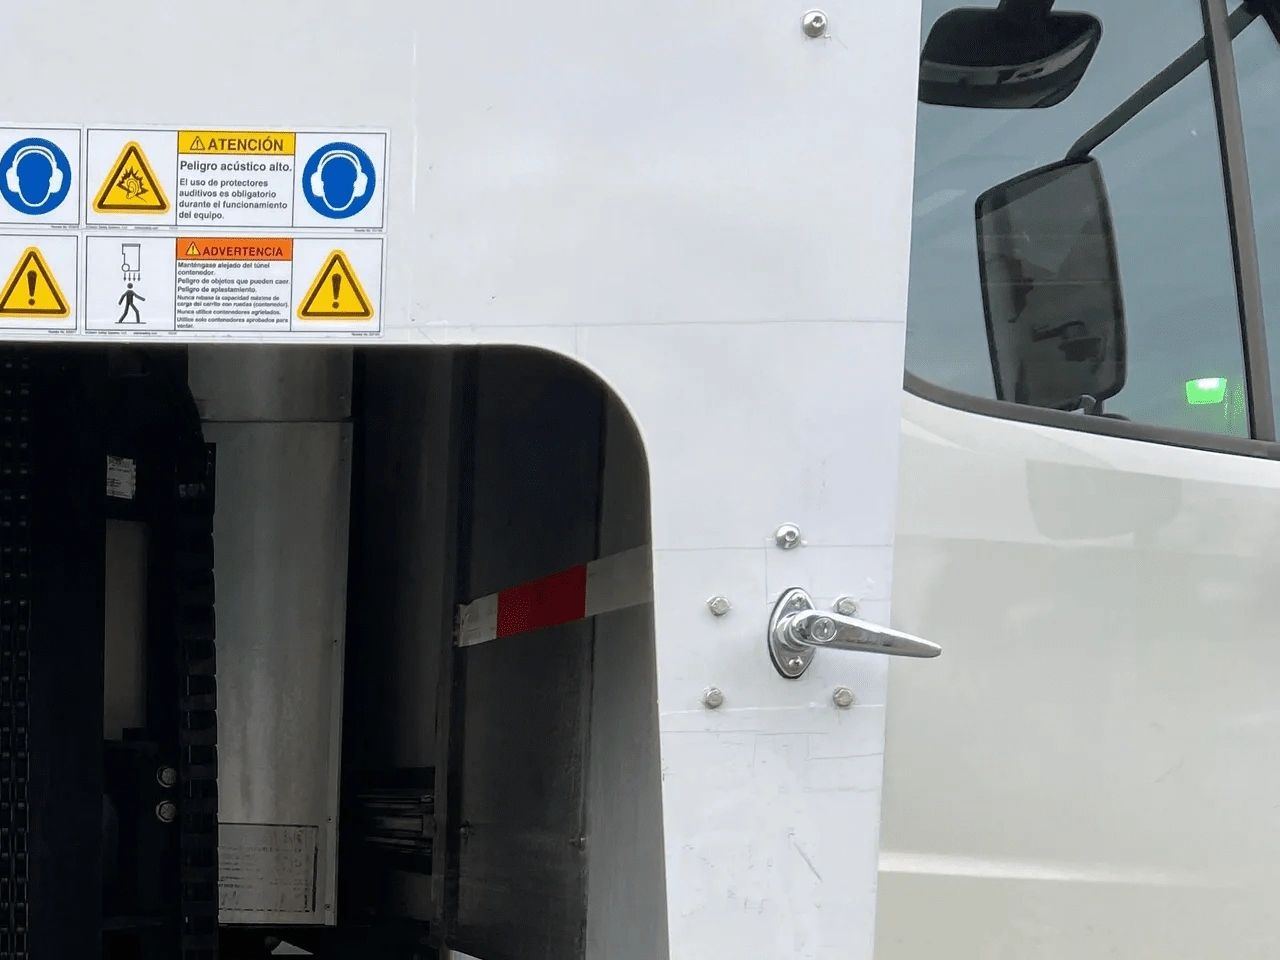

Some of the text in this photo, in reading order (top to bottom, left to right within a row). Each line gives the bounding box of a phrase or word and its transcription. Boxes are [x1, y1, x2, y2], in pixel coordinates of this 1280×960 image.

[208, 136, 283, 151] ATENCIÓN
[180, 160, 292, 173] Peligro acústico alto.
[179, 178, 187, 186] El
[208, 178, 218, 186] de
[220, 179, 268, 188] protectores
[179, 189, 217, 197] auditivos
[232, 190, 277, 199] obligatorio
[179, 200, 211, 208] durante
[222, 201, 288, 209] funcionamiento
[178, 211, 224, 220] del equipo.
[202, 246, 283, 256] ADVERTENCIA
